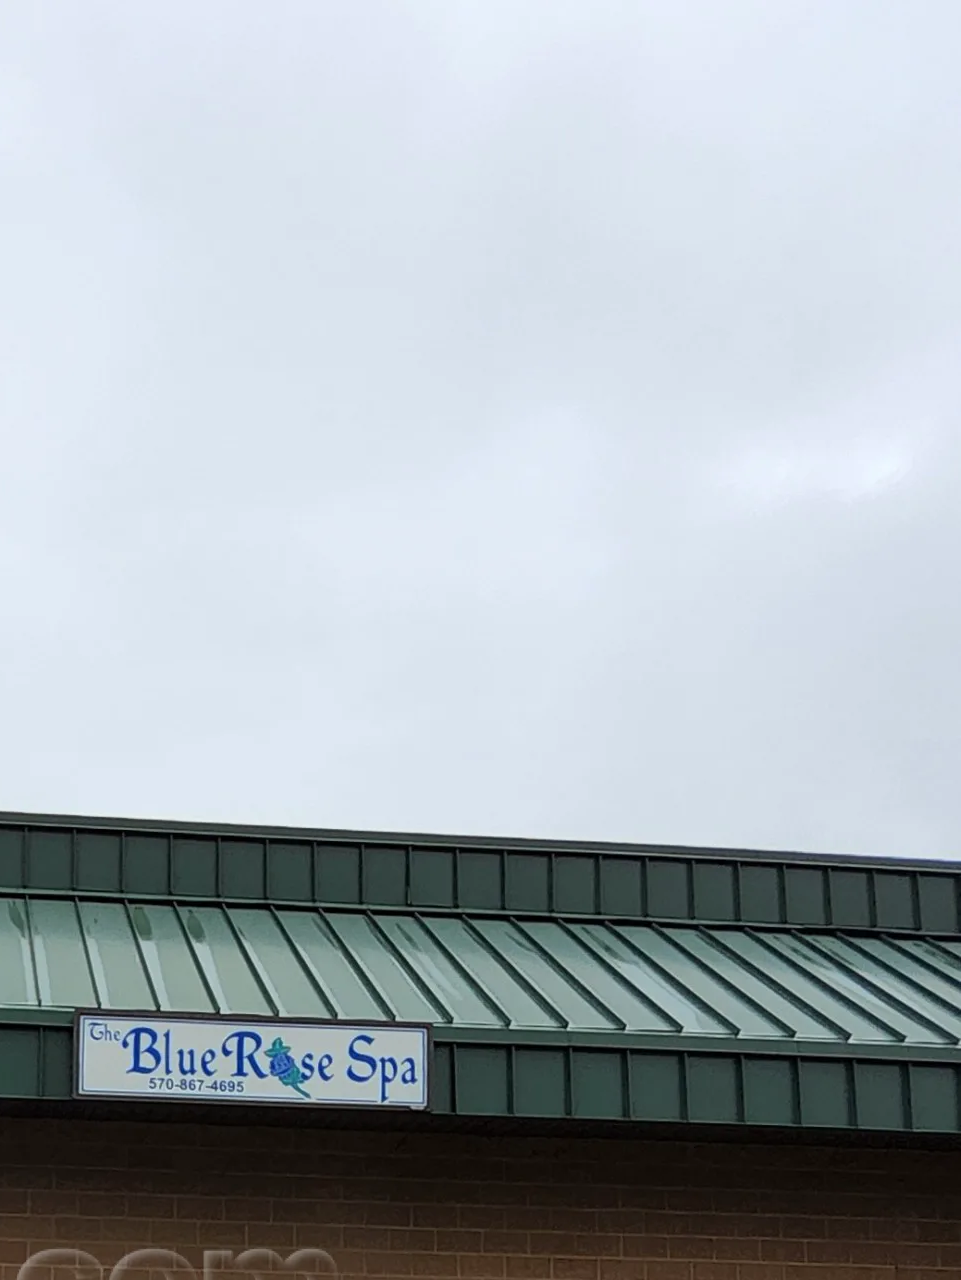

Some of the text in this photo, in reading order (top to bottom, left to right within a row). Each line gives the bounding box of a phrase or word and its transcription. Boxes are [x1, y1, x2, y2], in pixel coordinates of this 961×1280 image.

[88, 1022, 121, 1043] The
[122, 1026, 216, 1079] Blue
[346, 1034, 418, 1102] Spa
[148, 1077, 244, 1094] 570-867-4695
